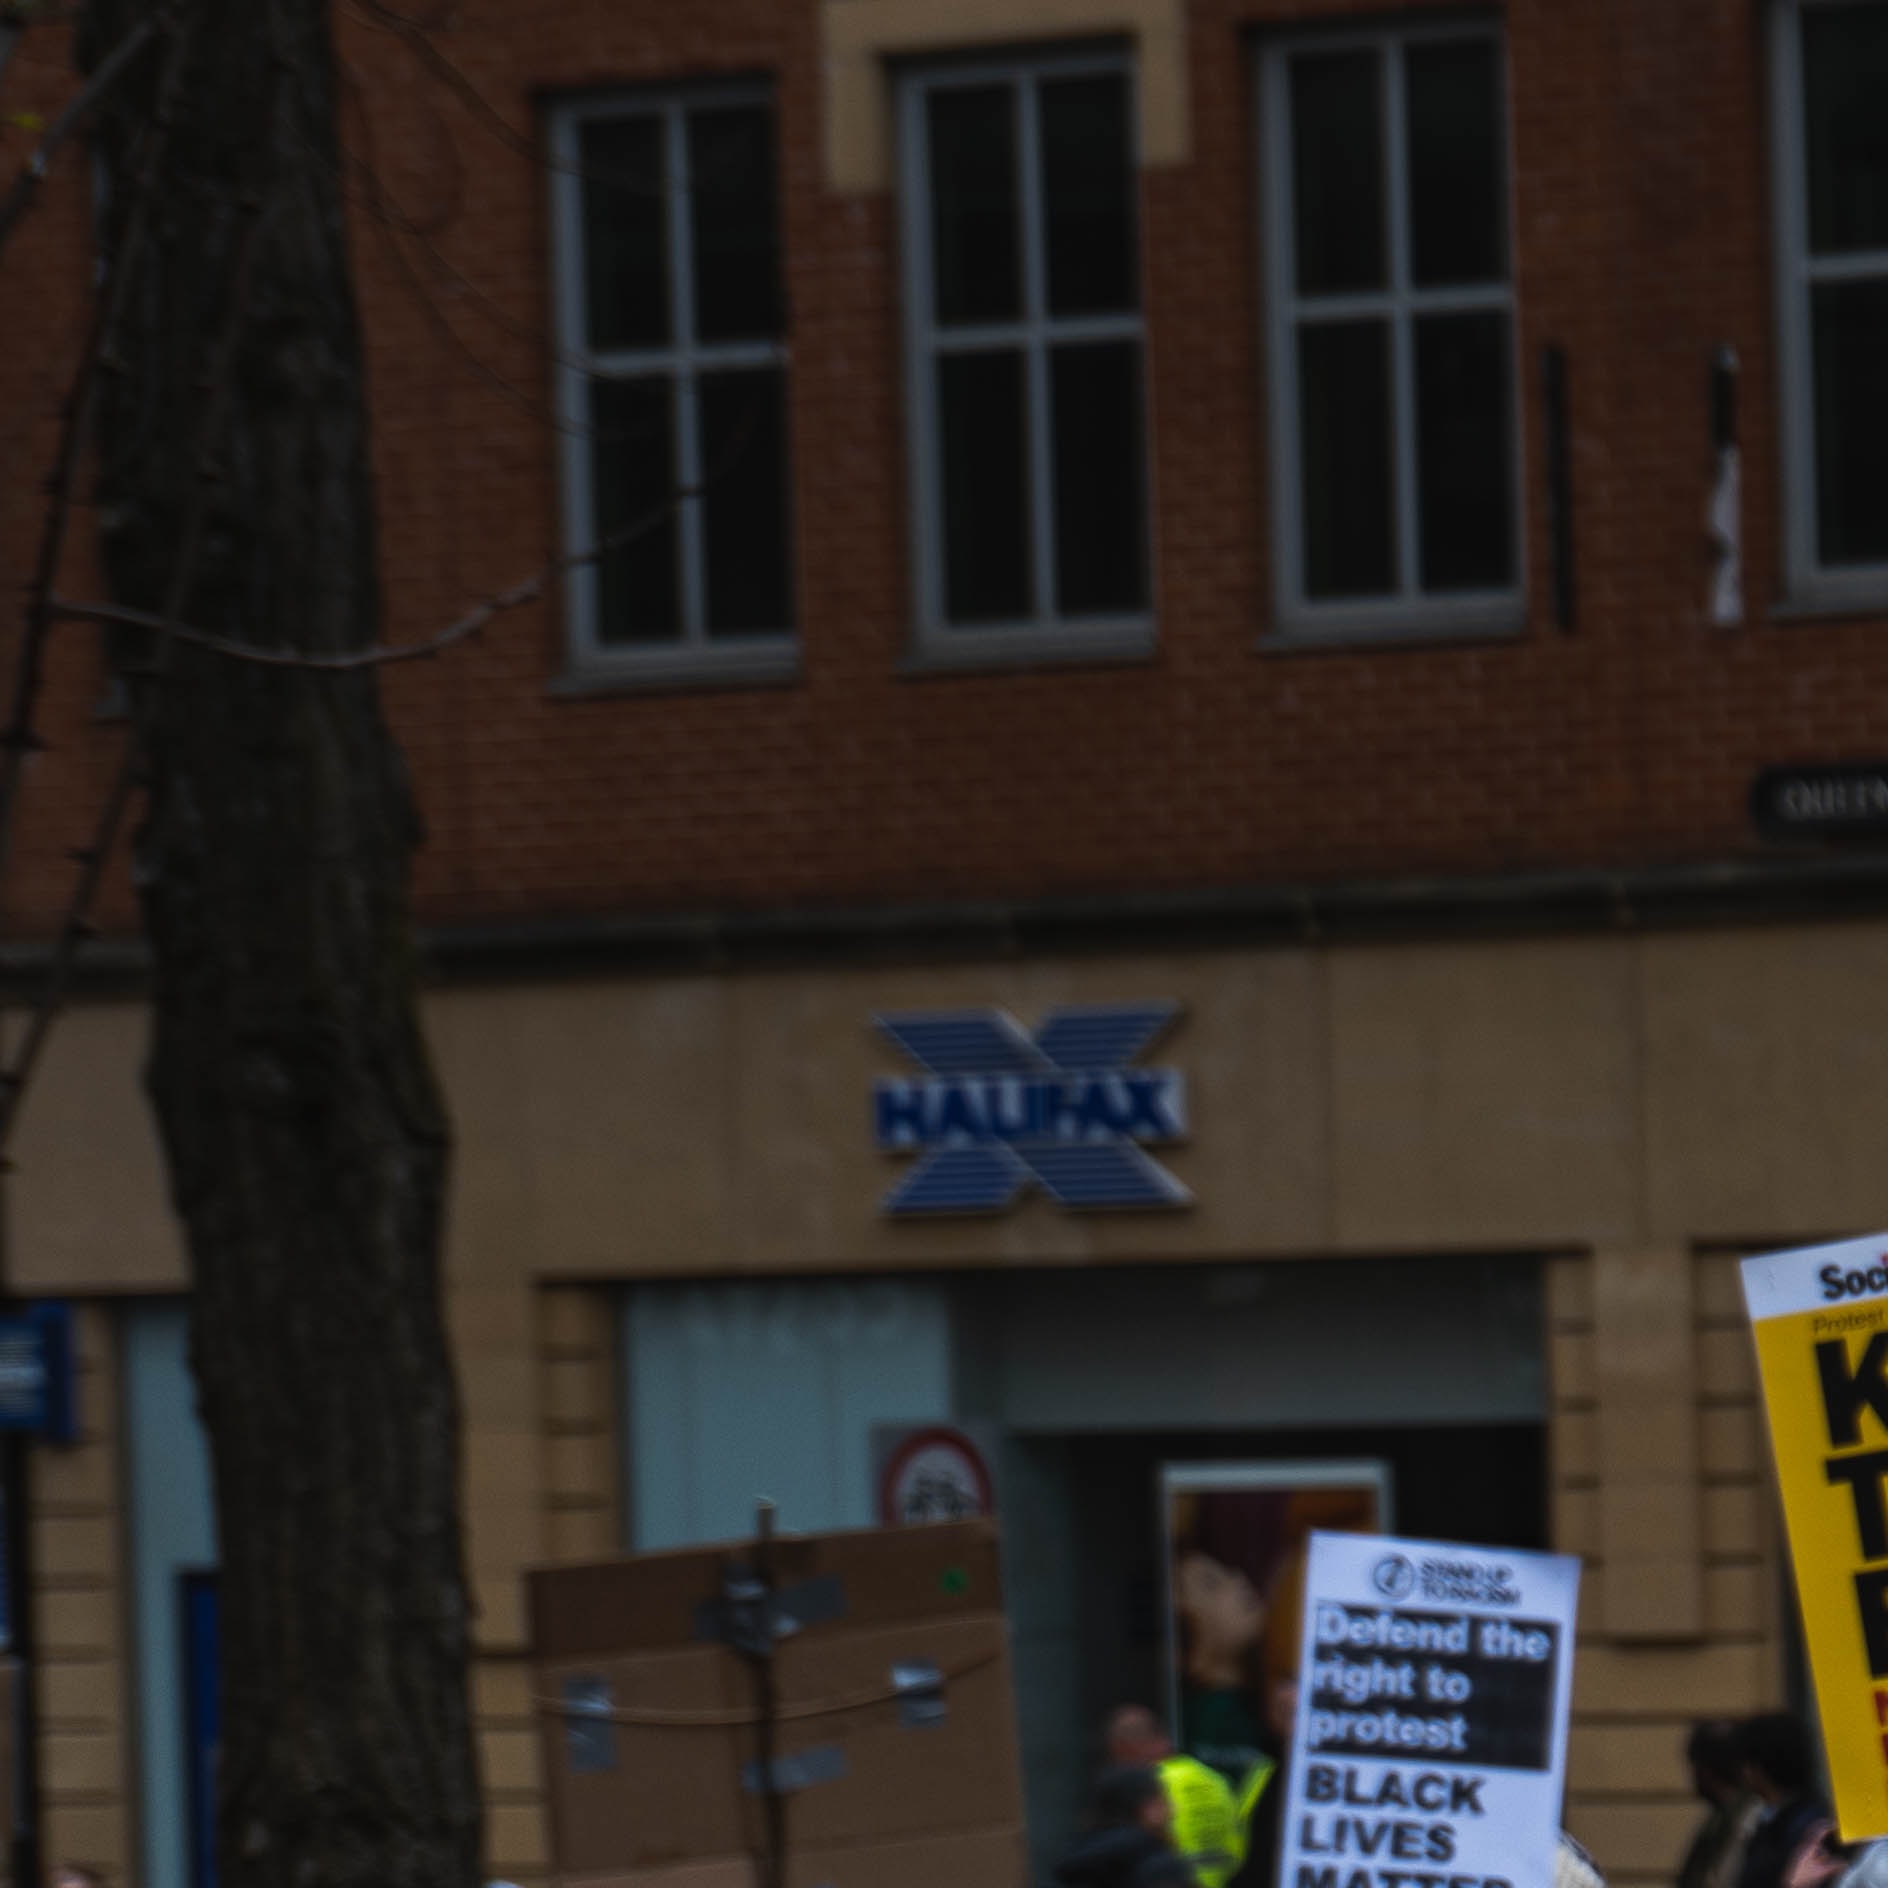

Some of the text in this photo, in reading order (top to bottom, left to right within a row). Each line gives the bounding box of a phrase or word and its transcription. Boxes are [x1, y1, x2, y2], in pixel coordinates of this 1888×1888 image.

[875, 1074, 1183, 1148] HALIFAX
[1316, 1603, 1552, 1663] Defend the
[1311, 1651, 1474, 1705] right to
[1306, 1704, 1470, 1754] protest
[1305, 1765, 1485, 1815] BLACK
[1299, 1816, 1455, 1862] LIVES
